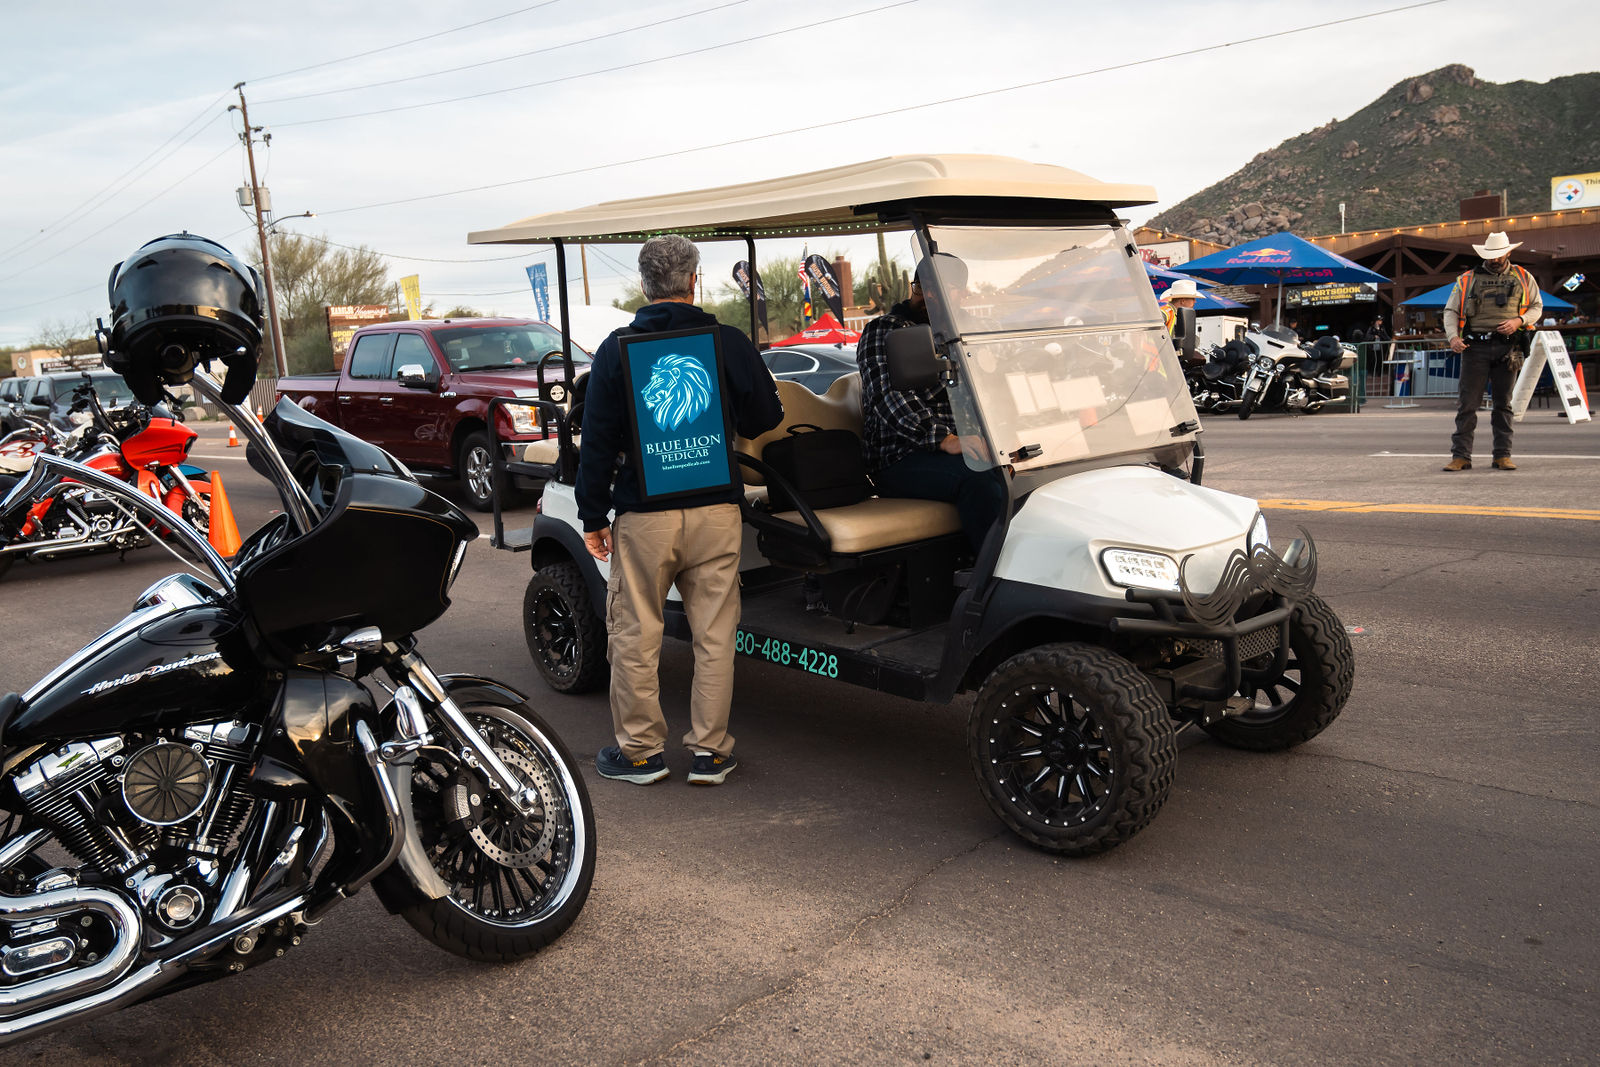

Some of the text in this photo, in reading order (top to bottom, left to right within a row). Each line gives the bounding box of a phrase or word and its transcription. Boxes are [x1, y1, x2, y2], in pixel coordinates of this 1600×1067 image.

[1226, 256, 1258, 264] Red
[810, 262, 823, 278] RUSS
[819, 276, 836, 297] BROWN
[1301, 286, 1361, 298] SPORTSBOOK
[332, 330, 354, 338] SPORT
[645, 433, 721, 454] BLUE LION
[661, 448, 709, 463] PEDICAB
[661, 460, 711, 471] bluelionpedicab.com
[735, 630, 838, 678] 80-488-4228
[80, 651, 223, 695] Harley-Davidson
